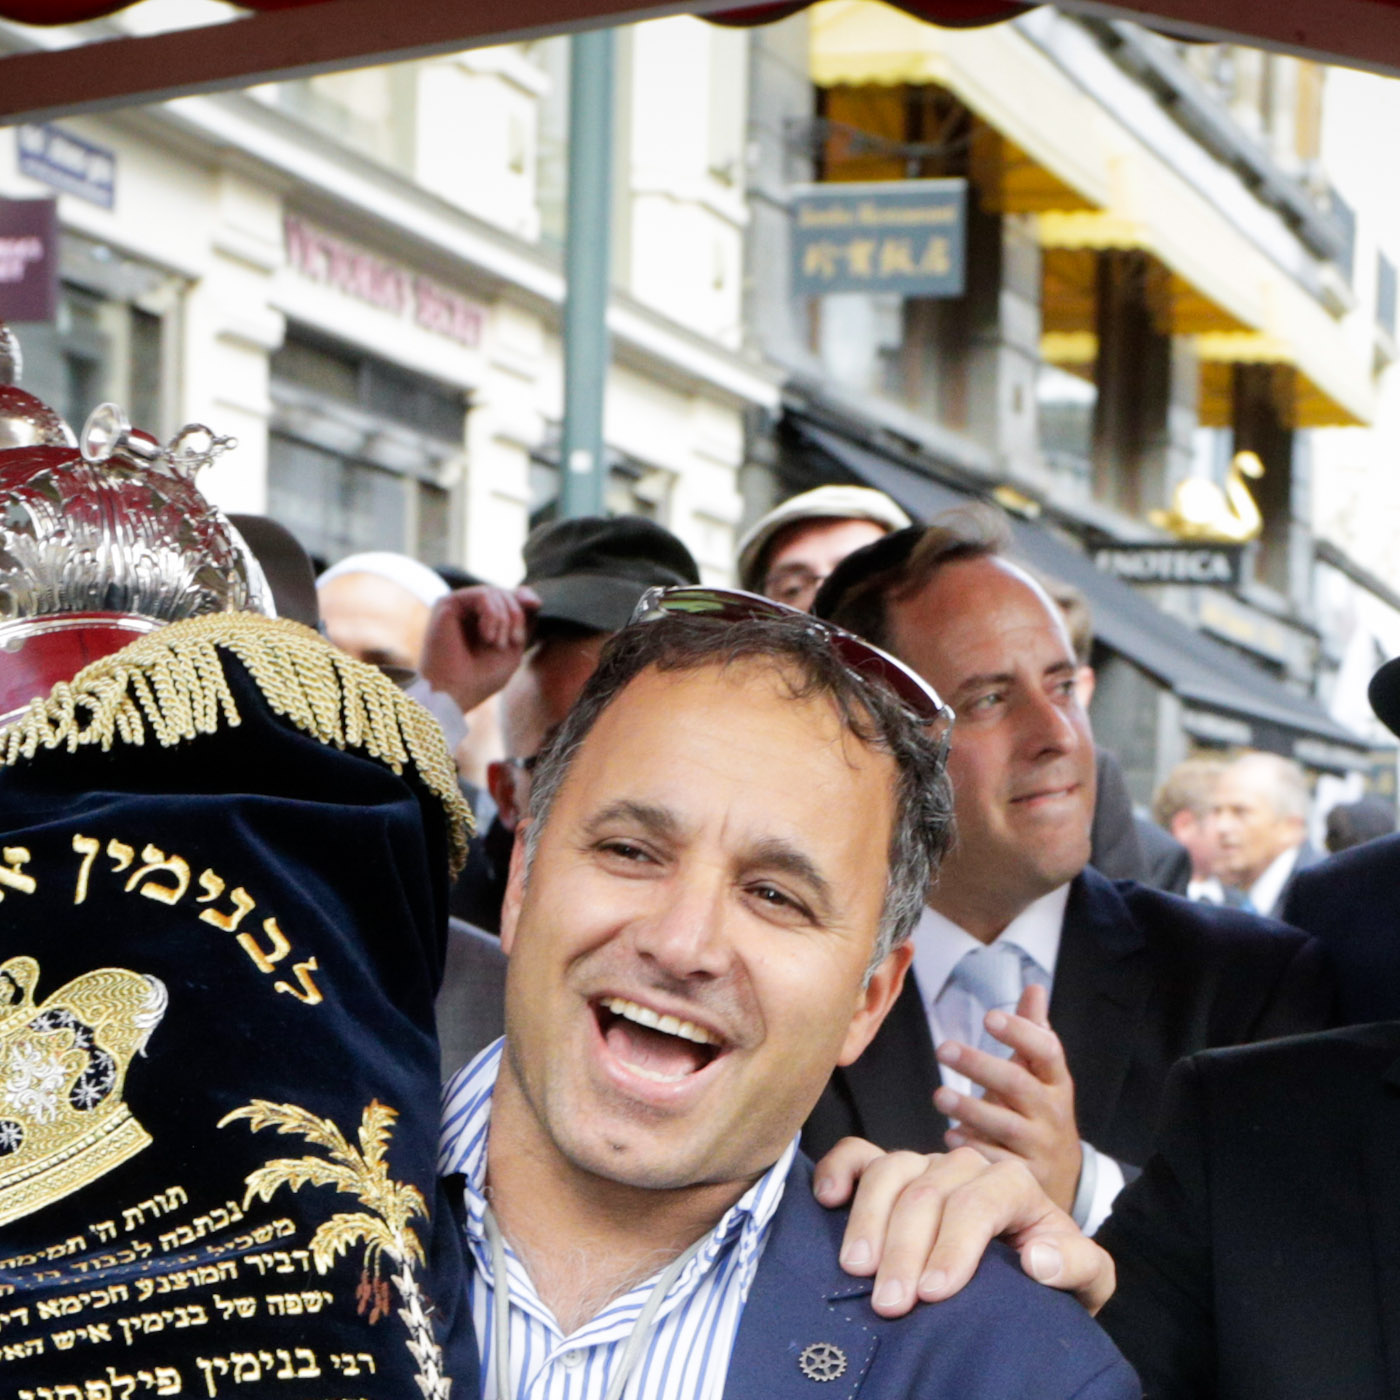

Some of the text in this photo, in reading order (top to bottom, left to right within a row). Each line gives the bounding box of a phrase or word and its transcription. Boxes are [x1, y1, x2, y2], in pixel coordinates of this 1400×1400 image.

[72, 833, 323, 1005] לבנימין
[122, 1186, 188, 1231] תורת
[159, 1201, 244, 1251] נכתבה
[135, 1260, 238, 1301] המוצנע
[244, 1250, 309, 1275] דביר
[37, 1283, 129, 1320] חכימא
[213, 1294, 257, 1320] של
[266, 1290, 334, 1315] ישפה
[51, 1324, 112, 1351] איש
[118, 1305, 208, 1345] בנימין
[196, 1347, 321, 1398] בנימין
[330, 1352, 375, 1375] רבי
